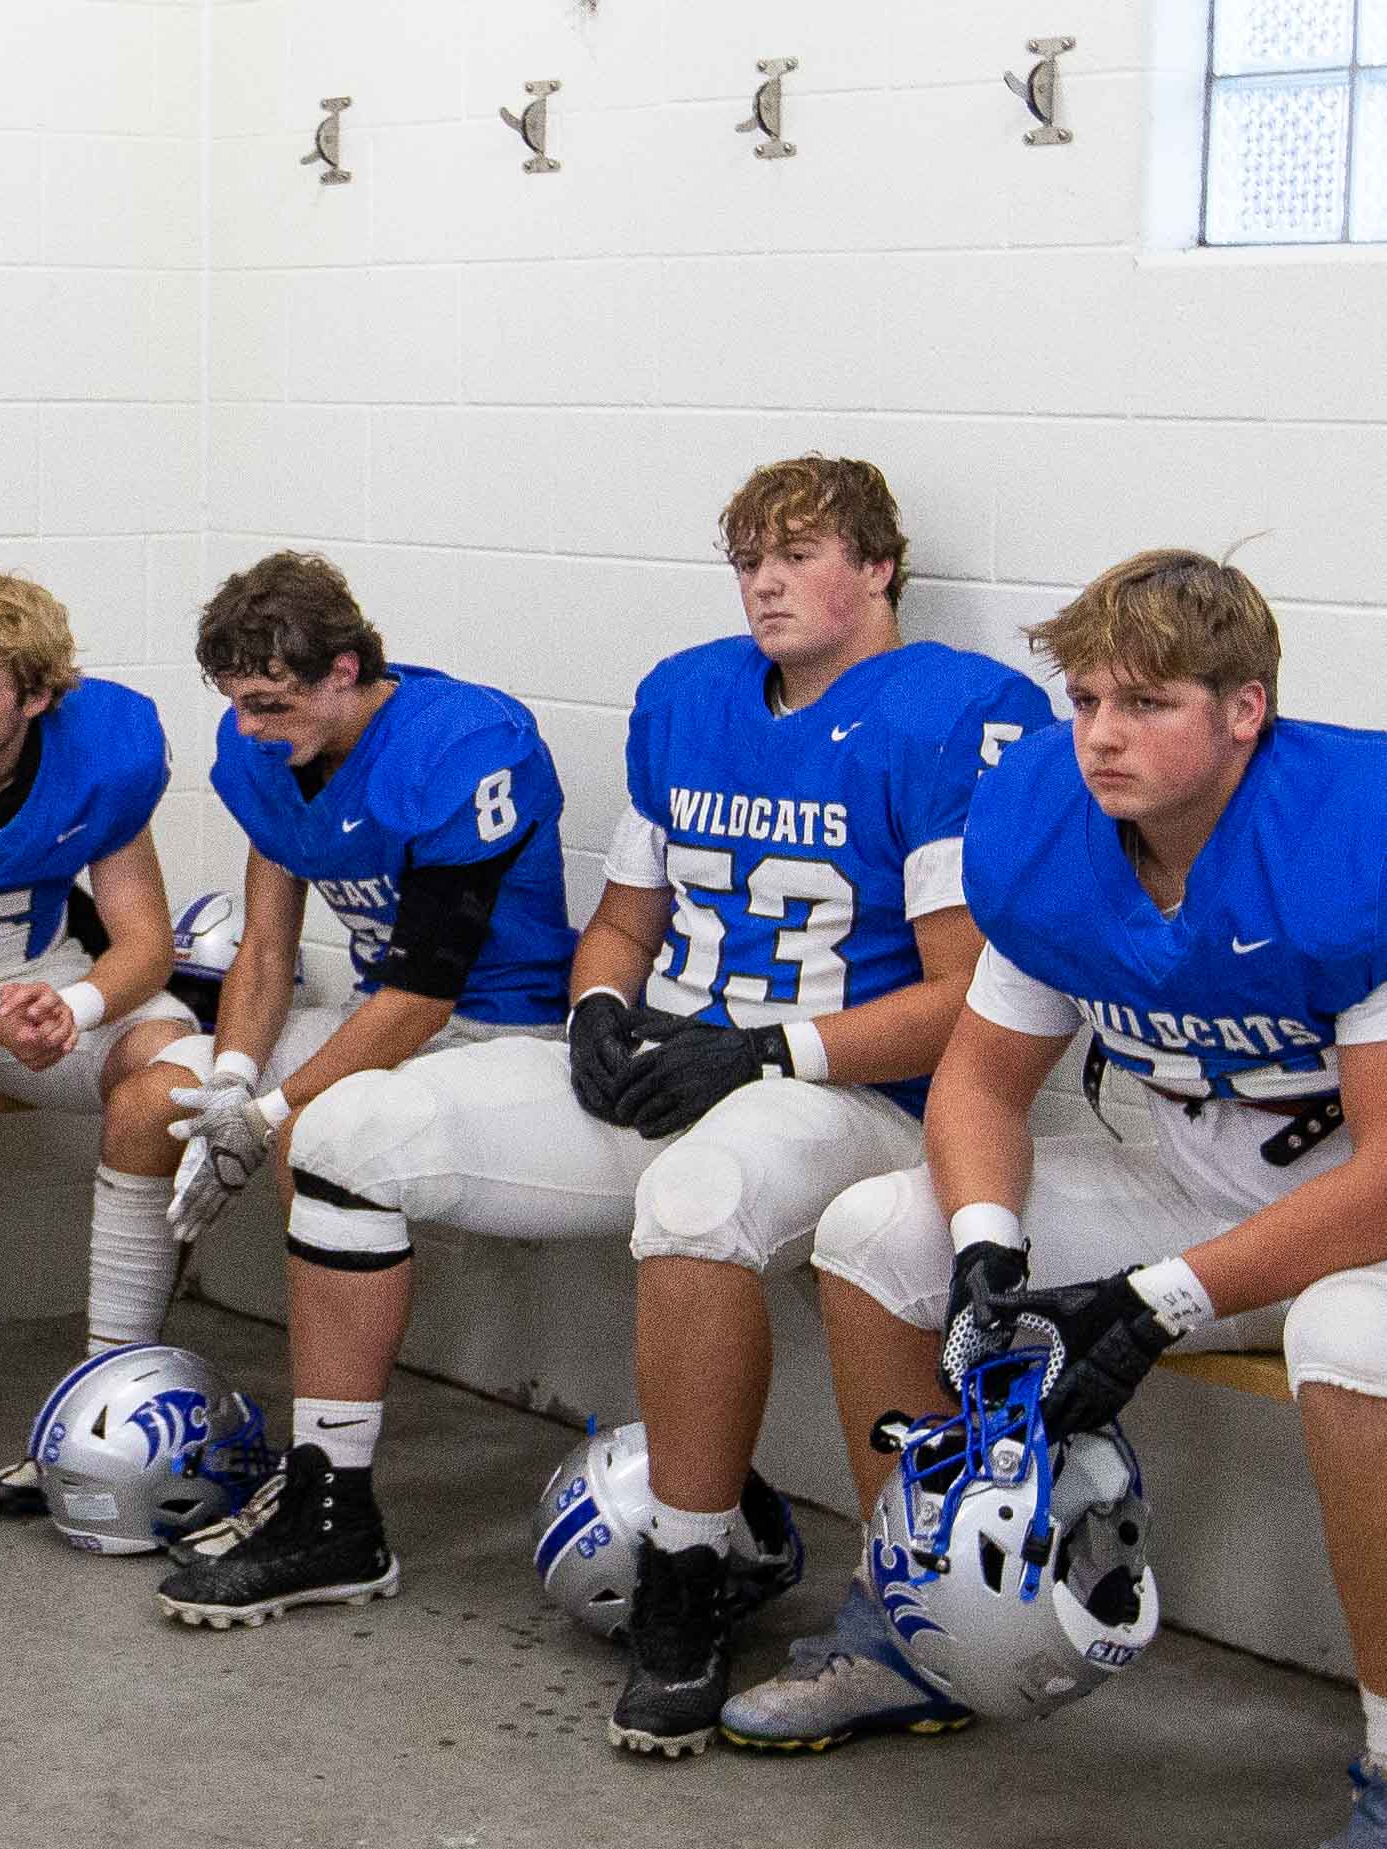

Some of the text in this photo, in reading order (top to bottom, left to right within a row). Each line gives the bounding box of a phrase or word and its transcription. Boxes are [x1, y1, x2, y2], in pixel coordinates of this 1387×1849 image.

[474, 768, 518, 843] 8
[669, 787, 848, 848] WILDCATS
[316, 875, 401, 908] CAT
[646, 841, 855, 1031] 53
